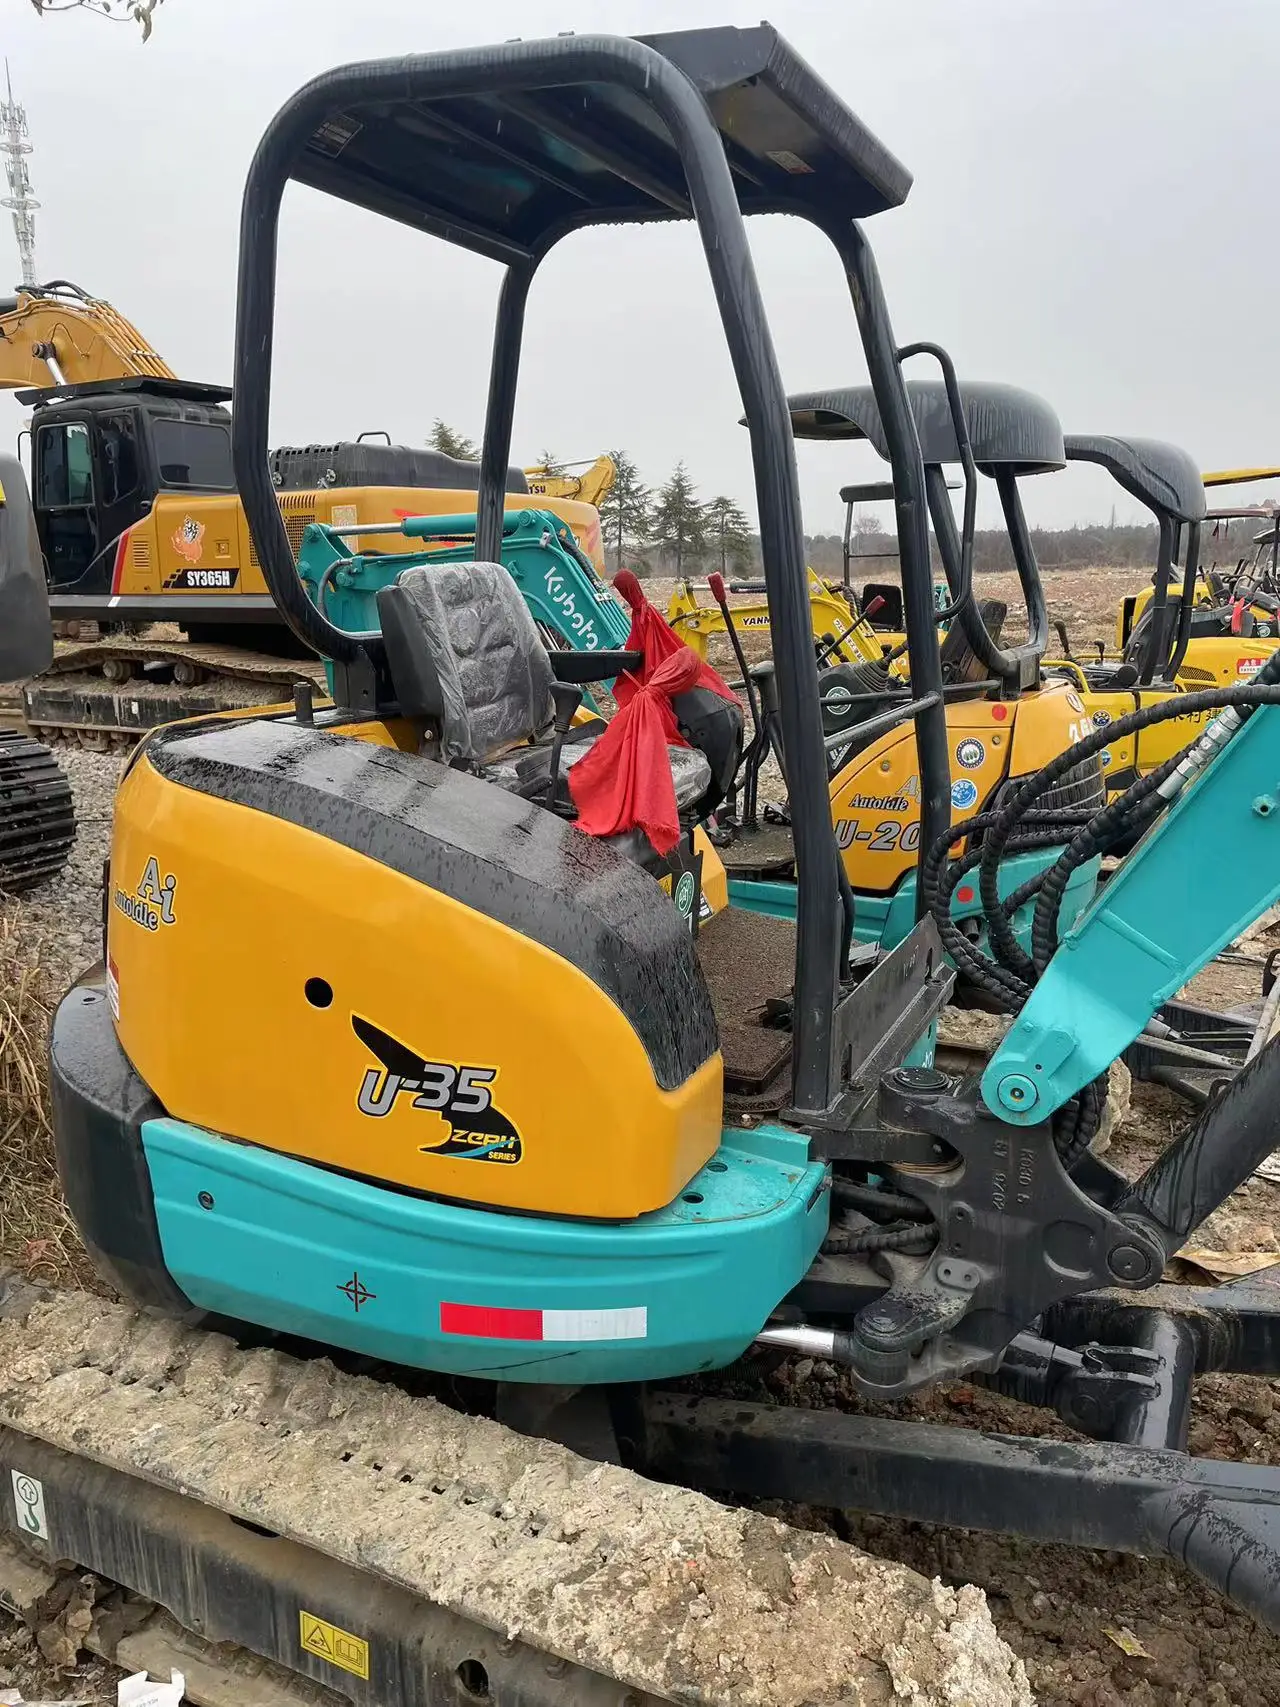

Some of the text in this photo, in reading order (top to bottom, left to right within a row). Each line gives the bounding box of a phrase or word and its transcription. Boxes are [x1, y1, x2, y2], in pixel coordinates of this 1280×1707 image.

[186, 570, 231, 586] SY365H
[137, 856, 177, 923] Ai
[358, 1063, 498, 1117] U-35
[488, 1151, 517, 1162] SERIES
